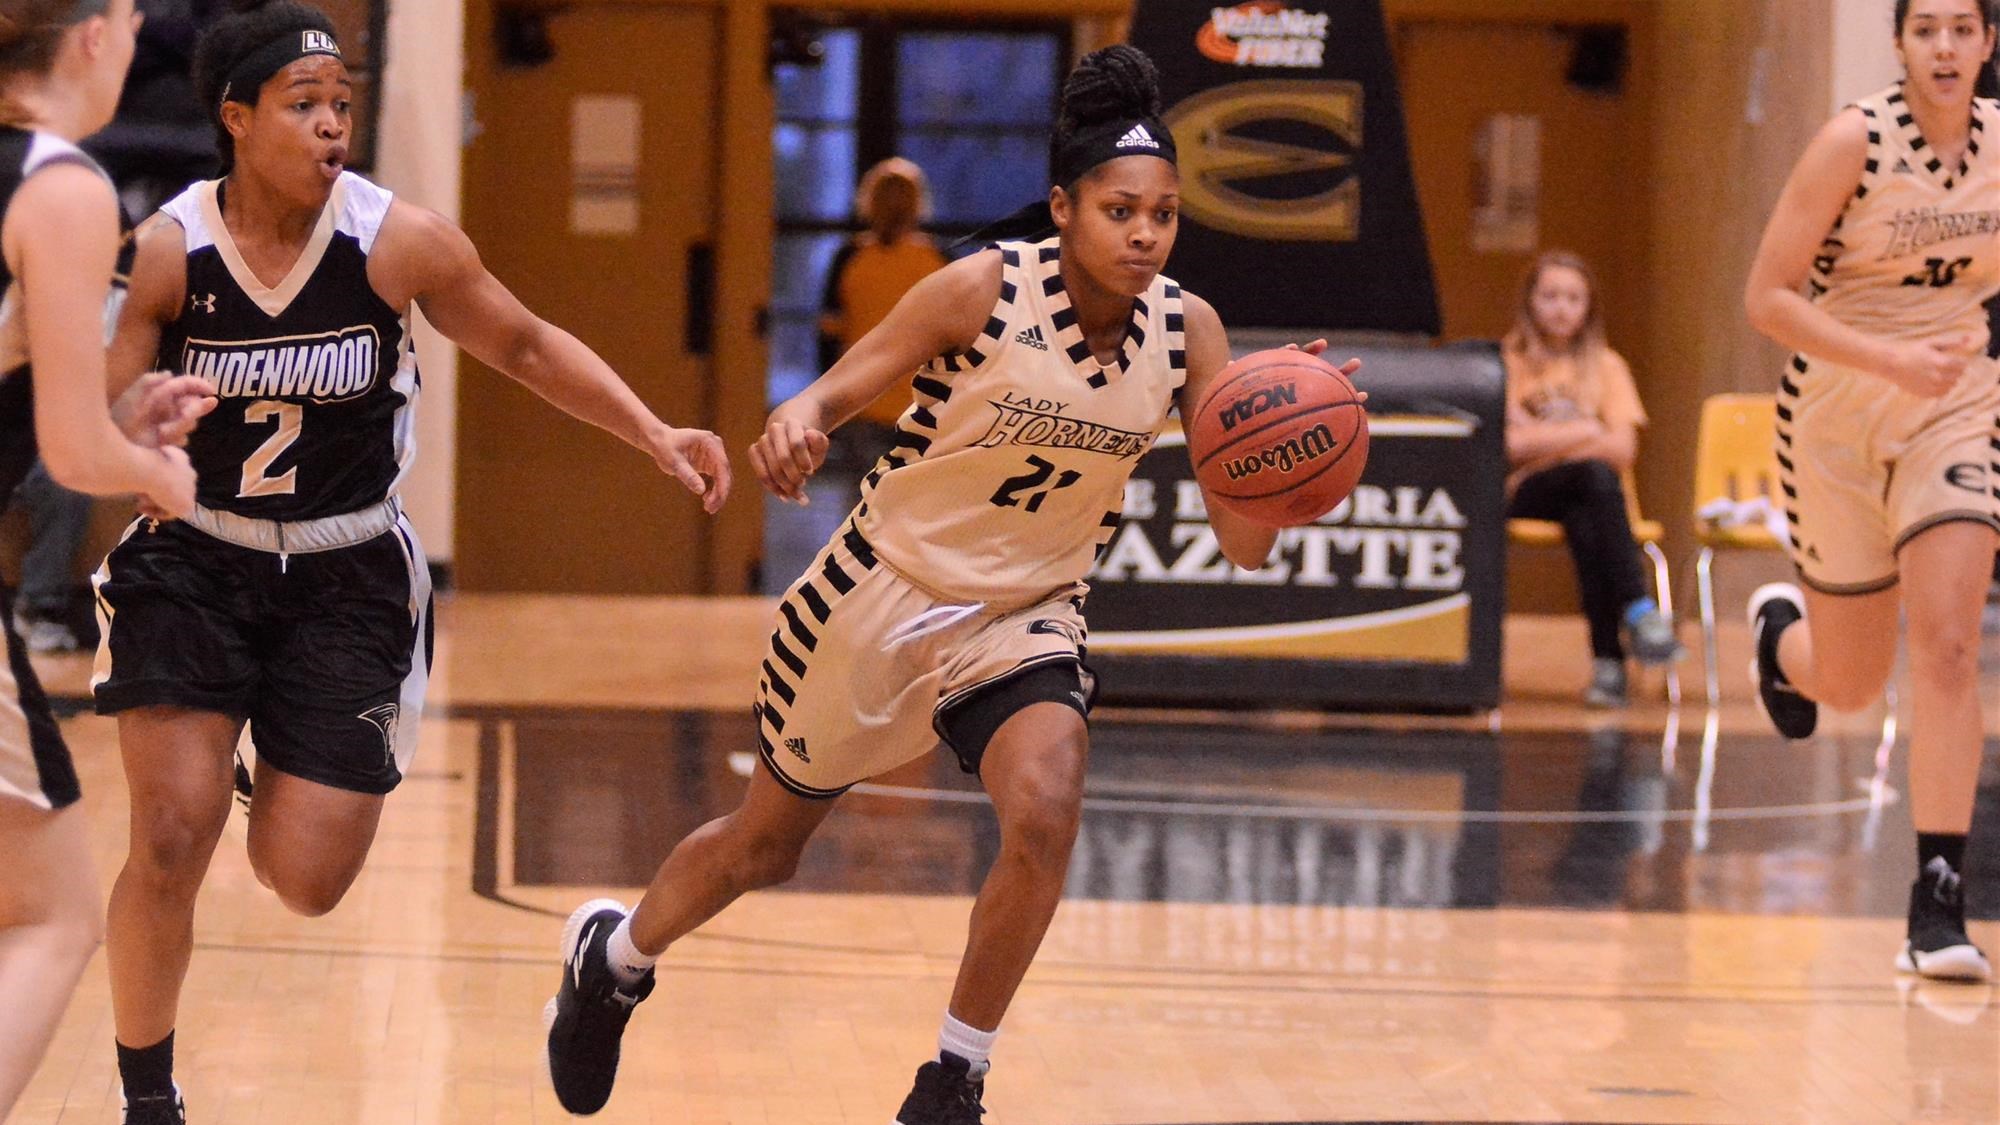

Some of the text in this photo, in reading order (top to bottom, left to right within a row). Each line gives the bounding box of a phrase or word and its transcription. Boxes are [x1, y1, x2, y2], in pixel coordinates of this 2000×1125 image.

[1115, 138, 1160, 149] adidas
[1015, 335, 1048, 352] adidas
[1002, 391, 1070, 414] LADY
[1219, 382, 1298, 432] NCAA
[235, 400, 304, 498] 2
[1221, 422, 1338, 481] Wilson
[989, 454, 1082, 513] 21
